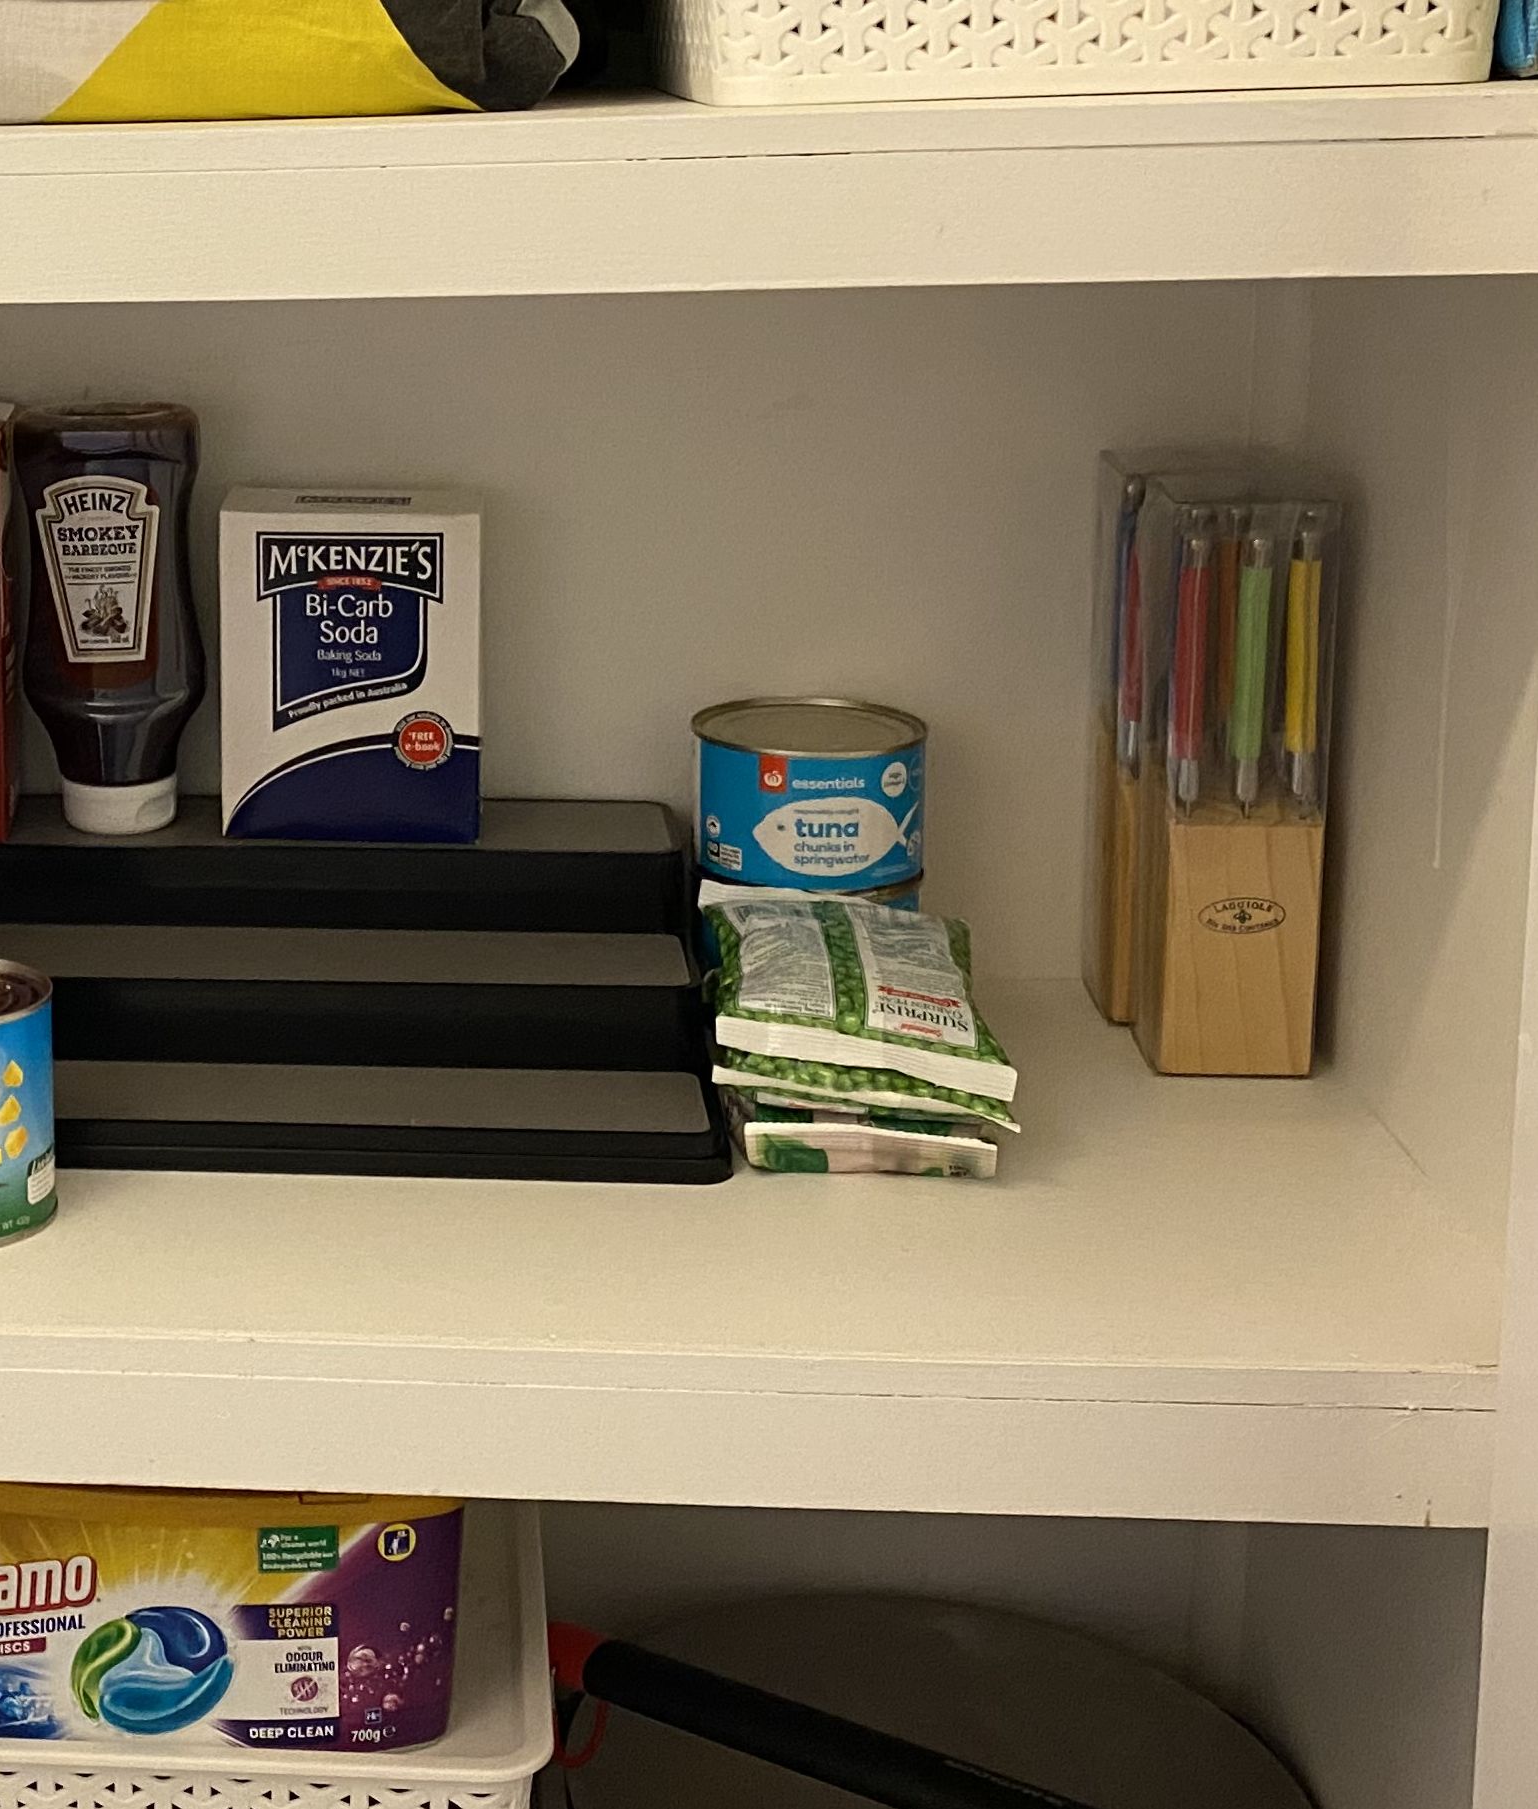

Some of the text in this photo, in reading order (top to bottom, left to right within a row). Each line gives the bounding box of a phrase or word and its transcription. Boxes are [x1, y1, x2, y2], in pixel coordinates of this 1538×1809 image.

[64, 492, 127, 515] HEINZ
[57, 525, 140, 542] SMOKEY
[62, 543, 137, 556] BARBEQUE
[268, 541, 433, 581] McKENZIE'S
[305, 594, 393, 619] Bi-Carb
[320, 620, 379, 645] Soda
[317, 648, 383, 664] Baking Soda
[288, 700, 322, 719] Proudly
[323, 691, 355, 707] packed
[366, 682, 408, 698] Australia
[792, 776, 866, 790] essentials
[794, 818, 859, 837] tuna
[794, 841, 855, 853] chunks in
[793, 854, 870, 868] springwater
[876, 1002, 969, 1033] SURPRISE
[2, 1220, 15, 1232] WT
[269, 1606, 332, 1618] SUPERIOR
[268, 1616, 332, 1628] CLEANING
[277, 1627, 324, 1638] POWER
[286, 1651, 323, 1663] ODOUR
[274, 1661, 335, 1674] ELIMINATING
[278, 1705, 329, 1716] TECHNOLOGY
[249, 1725, 334, 1739] DEEP CLEAN
[351, 1730, 381, 1744] 700g
